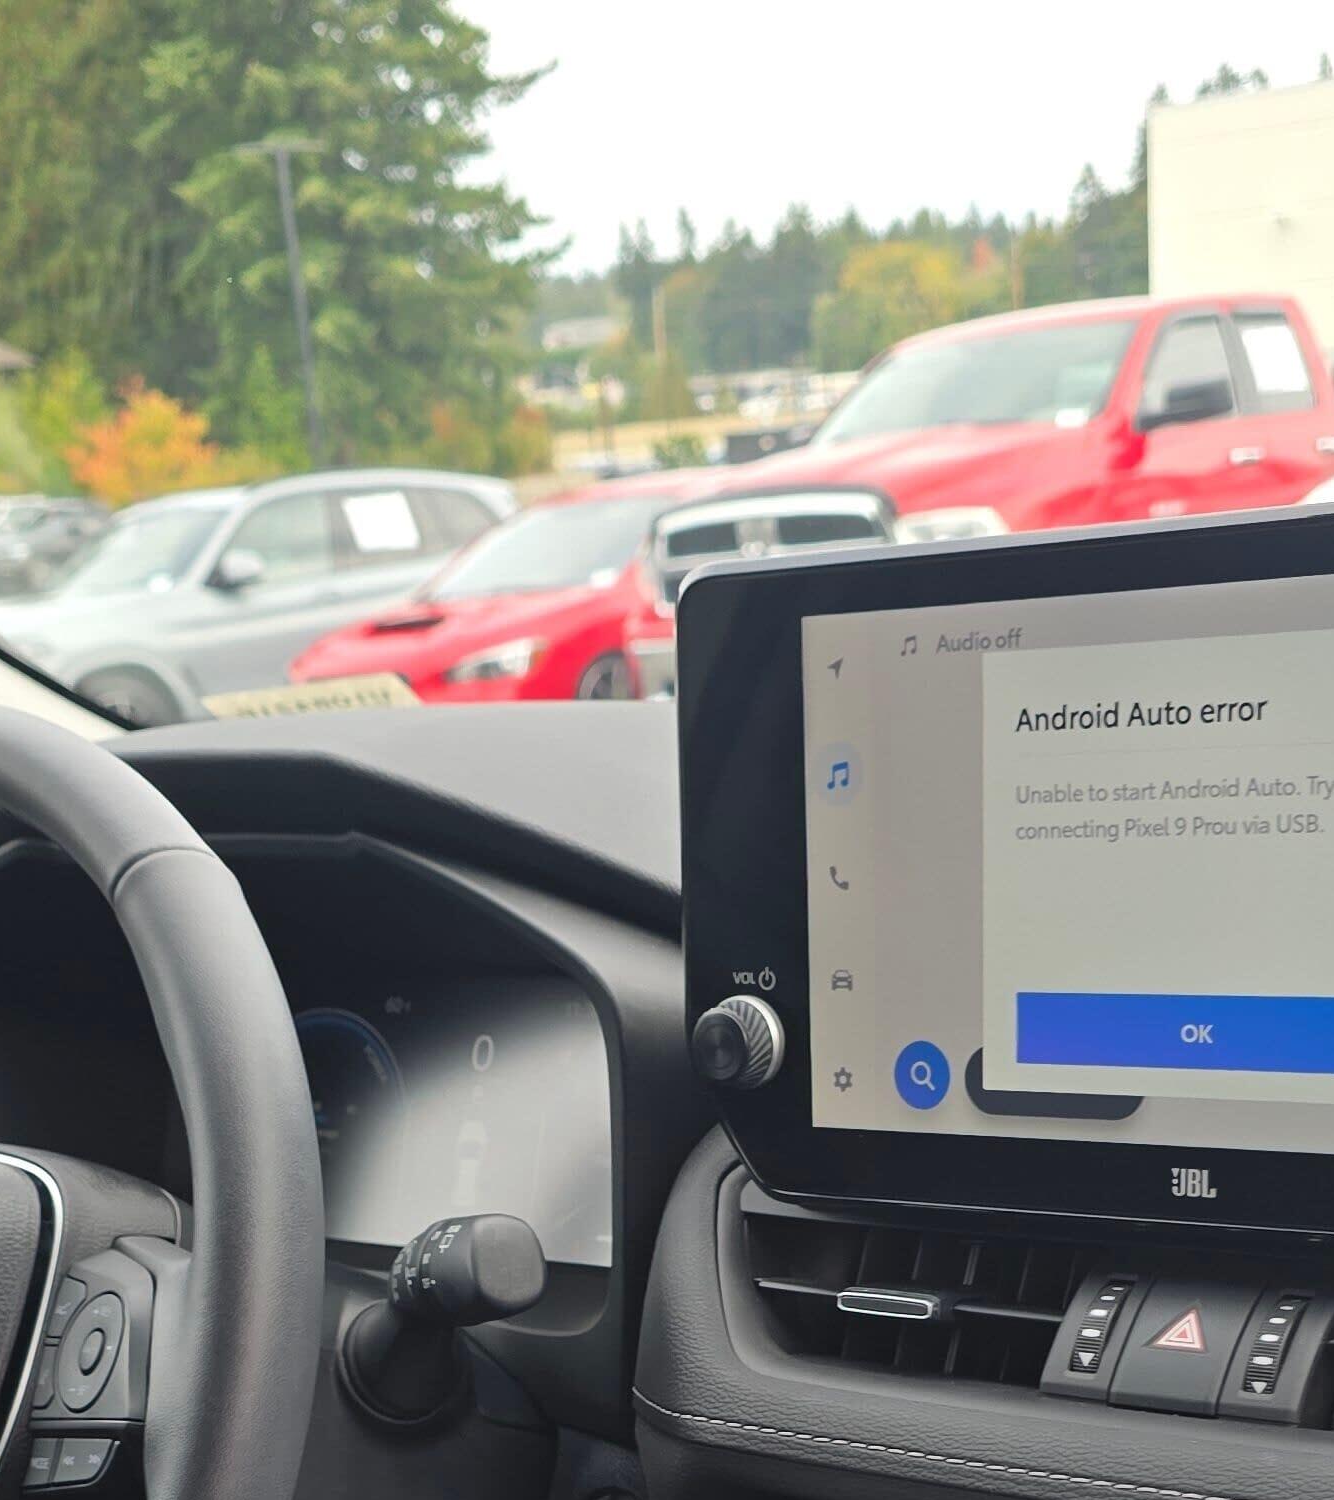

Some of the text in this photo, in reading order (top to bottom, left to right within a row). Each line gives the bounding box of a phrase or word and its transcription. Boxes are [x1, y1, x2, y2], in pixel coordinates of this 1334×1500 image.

[935, 627, 1024, 654] Audio off
[1015, 699, 1269, 732] Android Auto error
[1015, 783, 1084, 805] Unable
[1089, 784, 1108, 803] to
[1113, 781, 1156, 802] start
[1159, 777, 1240, 801] Android
[1245, 776, 1302, 798] Auto.
[1015, 813, 1326, 843] connecting Pixel 9 Prou via USB.
[732, 971, 756, 985] VOL
[1180, 1024, 1213, 1044] OK
[1171, 1167, 1217, 1199] JBL
